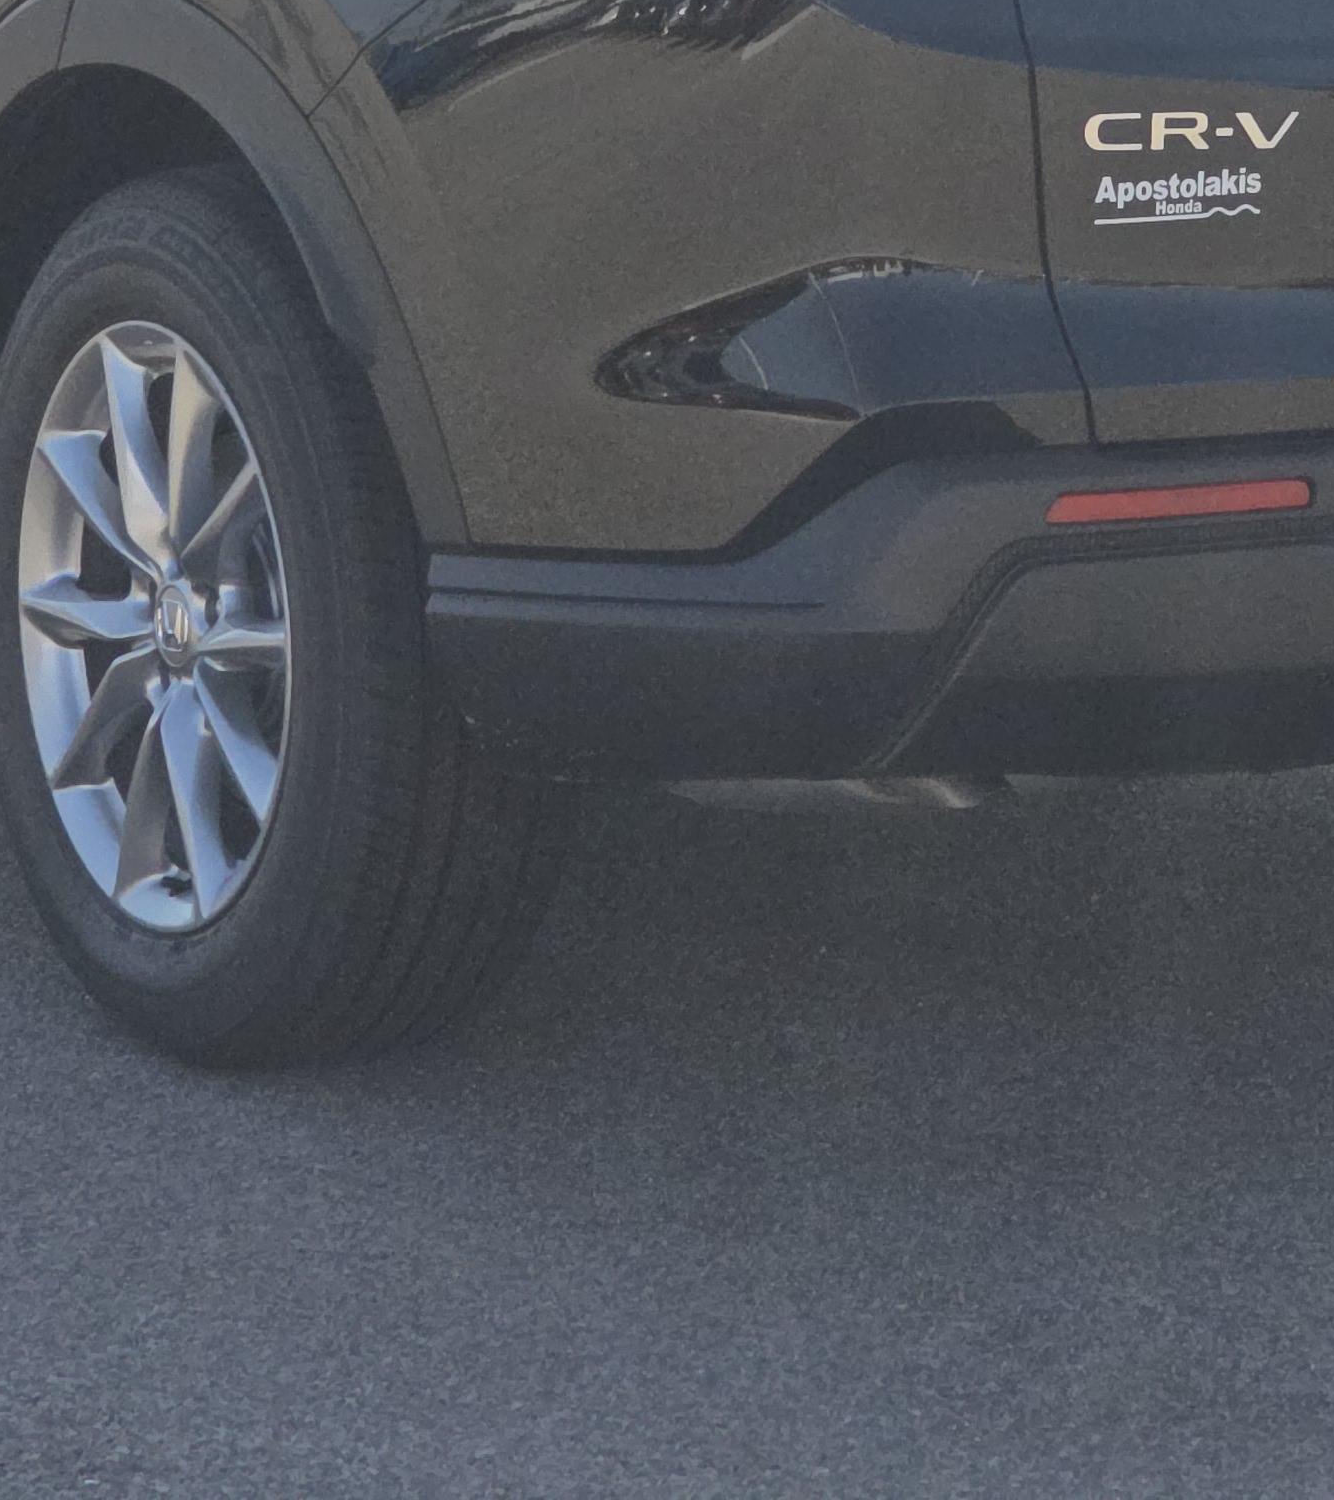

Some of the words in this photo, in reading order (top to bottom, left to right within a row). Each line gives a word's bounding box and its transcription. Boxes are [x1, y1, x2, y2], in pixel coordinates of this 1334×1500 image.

[1084, 111, 1300, 151] CR-V
[1094, 167, 1262, 209] Apostolakis
[1155, 199, 1203, 216] Honda
